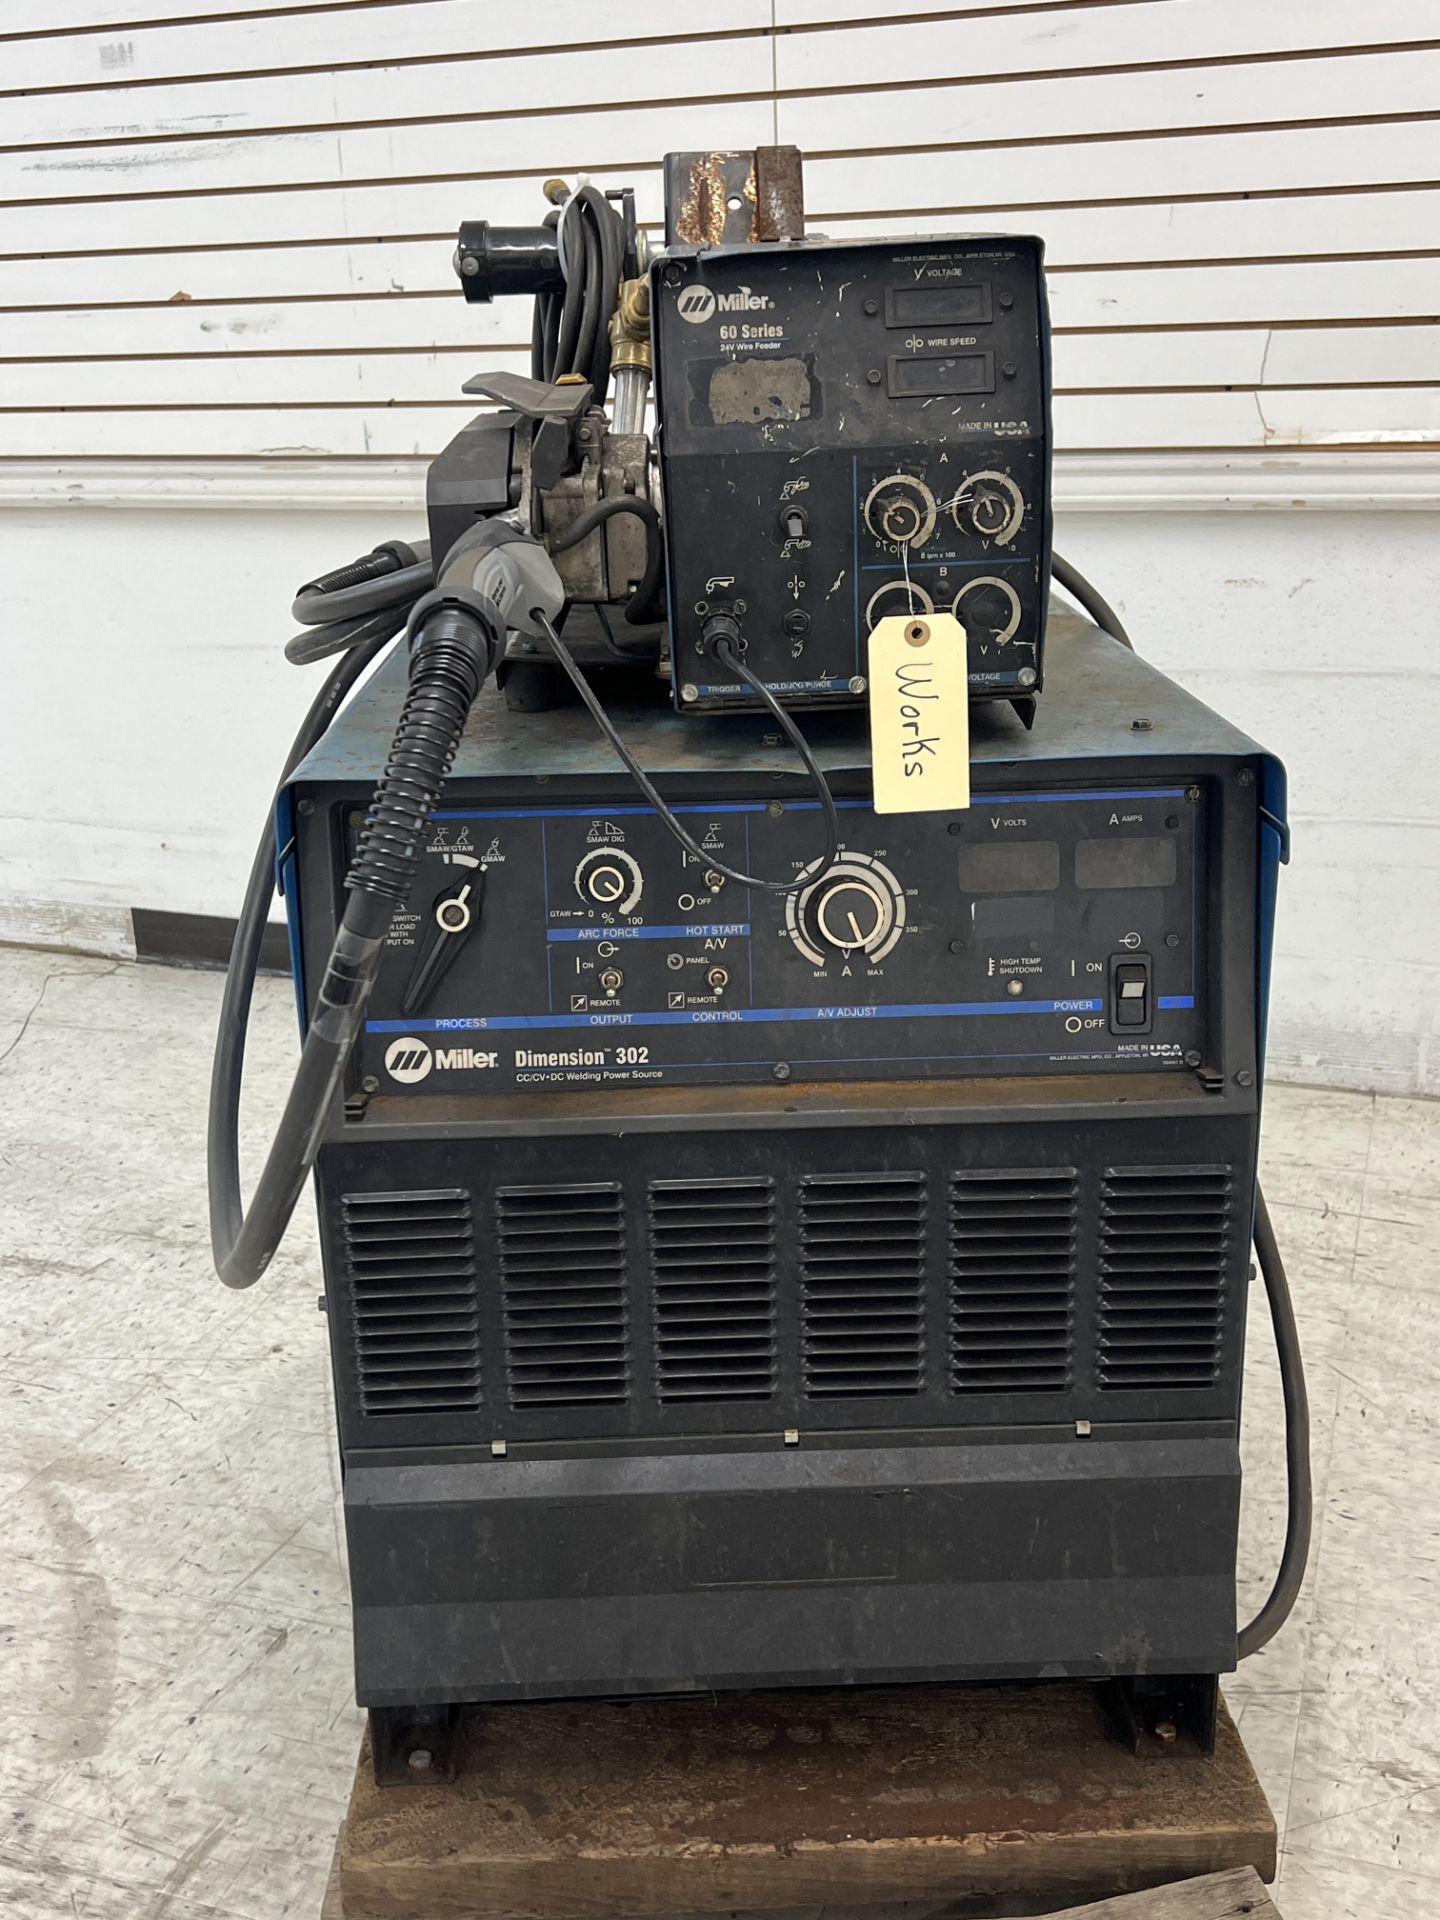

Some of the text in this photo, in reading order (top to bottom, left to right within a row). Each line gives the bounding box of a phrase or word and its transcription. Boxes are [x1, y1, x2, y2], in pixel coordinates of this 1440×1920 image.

[927, 268, 962, 277] VOLTAGE
[720, 323, 783, 339] 60 Series
[720, 341, 781, 351] 24V Wire Feeder
[928, 337, 976, 346] WIRE SPEED
[958, 421, 1029, 436] MADE IN USA
[940, 453, 948, 463] A
[981, 540, 989, 550] V
[940, 567, 948, 576] B
[980, 645, 988, 654] V
[895, 662, 940, 777] Works
[991, 818, 1027, 829] V VOLTS
[1109, 814, 1119, 825] A
[611, 835, 625, 843] DIG
[588, 910, 594, 918] 0
[602, 912, 615, 924] %
[628, 917, 643, 925] 100
[578, 928, 639, 938] ARC FORCE
[686, 925, 744, 935] HOT START
[704, 938, 727, 950] A/V
[842, 949, 851, 959] V
[1021, 957, 1041, 965] TEMP
[842, 965, 852, 976] A
[999, 966, 1043, 974] SHUTDOWN
[1086, 963, 1102, 972] ON
[590, 999, 621, 1007] REMOTE
[688, 996, 718, 1004] REMOTE
[1054, 1000, 1093, 1011] POWER
[692, 1012, 743, 1022] CONTROL
[817, 1008, 877, 1017] A/V ADJUST
[436, 1018, 487, 1028] PROCESS
[590, 1015, 633, 1024] OUTPUT
[1084, 1019, 1106, 1028] OFF
[616, 1047, 649, 1064] 302
[1150, 1044, 1182, 1057] USA
[566, 1072, 600, 1082] Welding
[603, 1071, 630, 1080] Power
[632, 1069, 663, 1078] Source
